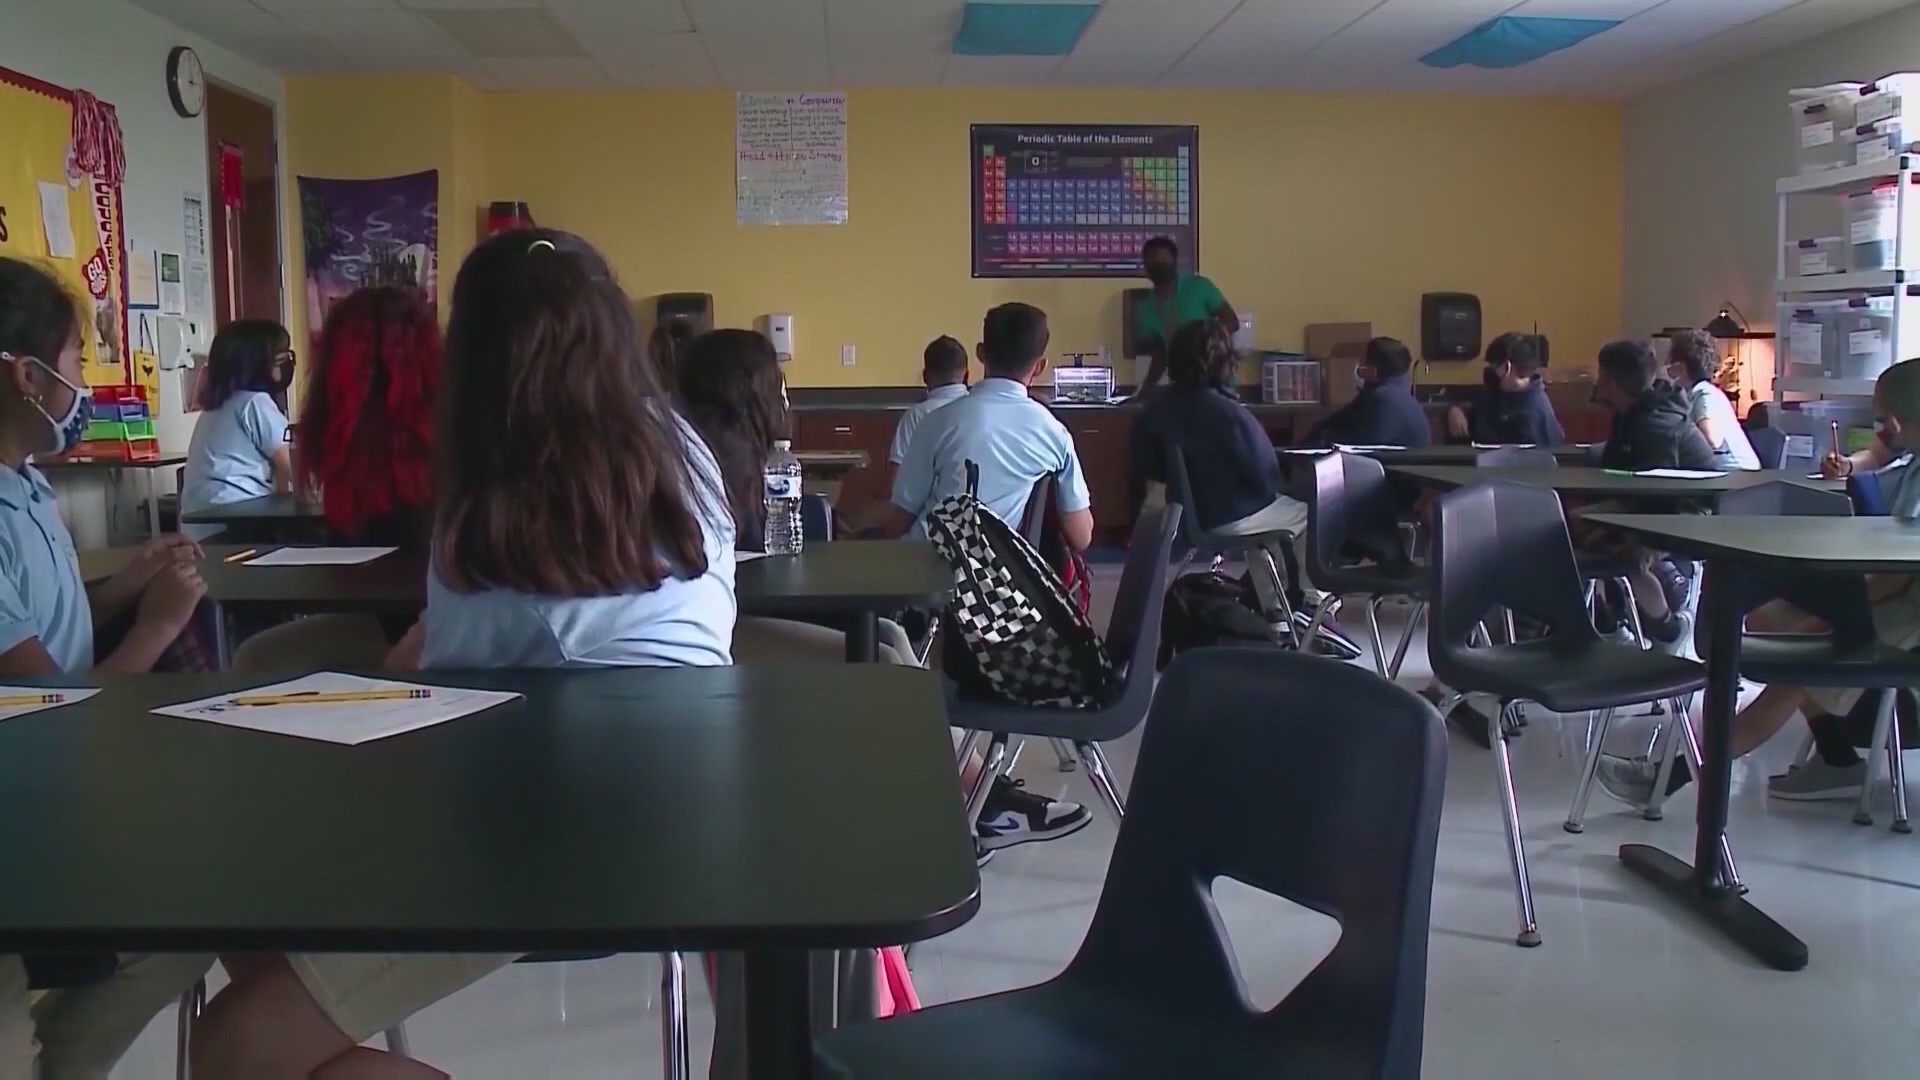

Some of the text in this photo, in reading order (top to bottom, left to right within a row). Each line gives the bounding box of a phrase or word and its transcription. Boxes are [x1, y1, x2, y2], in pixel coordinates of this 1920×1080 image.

[1017, 135, 1153, 144] Periodic Table of the Elements
[87, 256, 103, 281] GO
